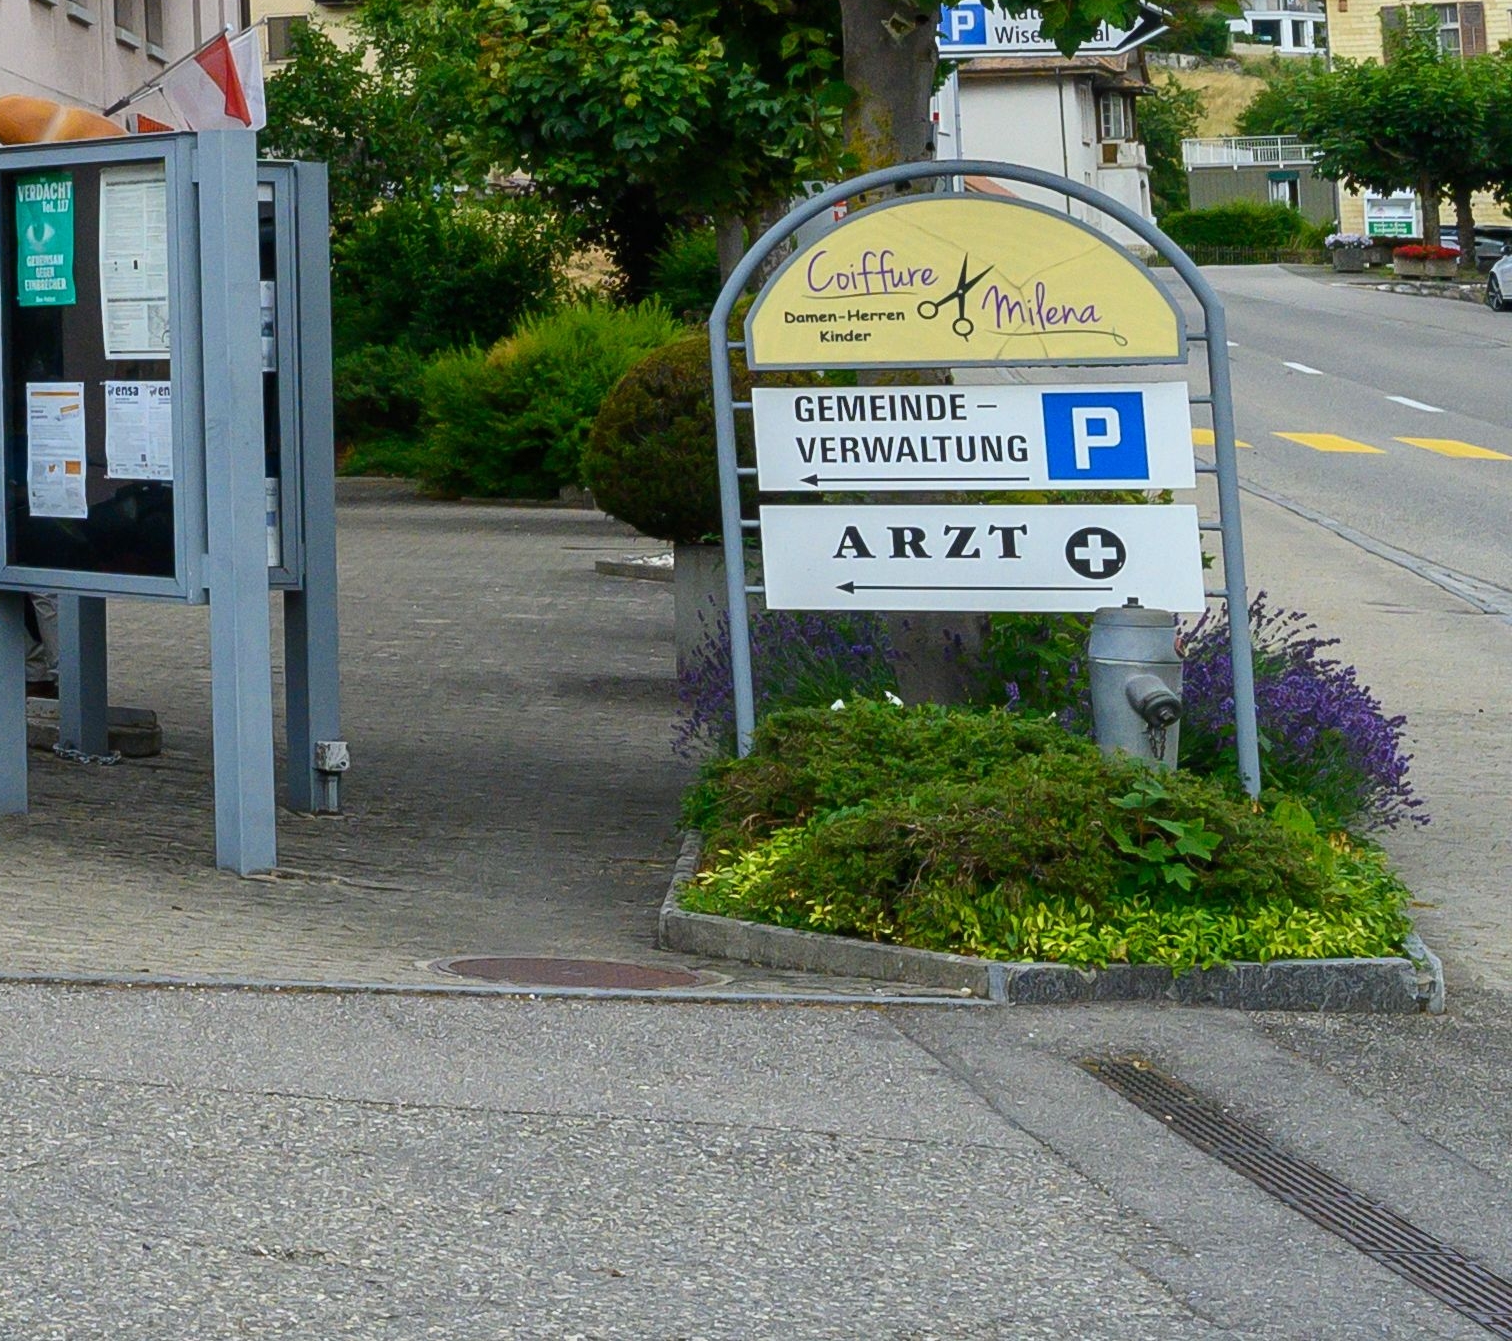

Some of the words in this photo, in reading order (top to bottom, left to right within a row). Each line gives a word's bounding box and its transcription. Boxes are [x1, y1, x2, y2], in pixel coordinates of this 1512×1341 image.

[950, 10, 975, 42] P
[17, 181, 72, 203] VERDACHT
[806, 249, 939, 296] Coiffure
[981, 281, 1103, 332] Milena
[783, 308, 906, 325] Damen-Herren
[819, 329, 872, 344] Kinder
[115, 386, 139, 397] ensa
[795, 434, 1029, 464] VERWALTUNG
[1071, 406, 1122, 470] P
[832, 524, 1028, 559] ARZT
